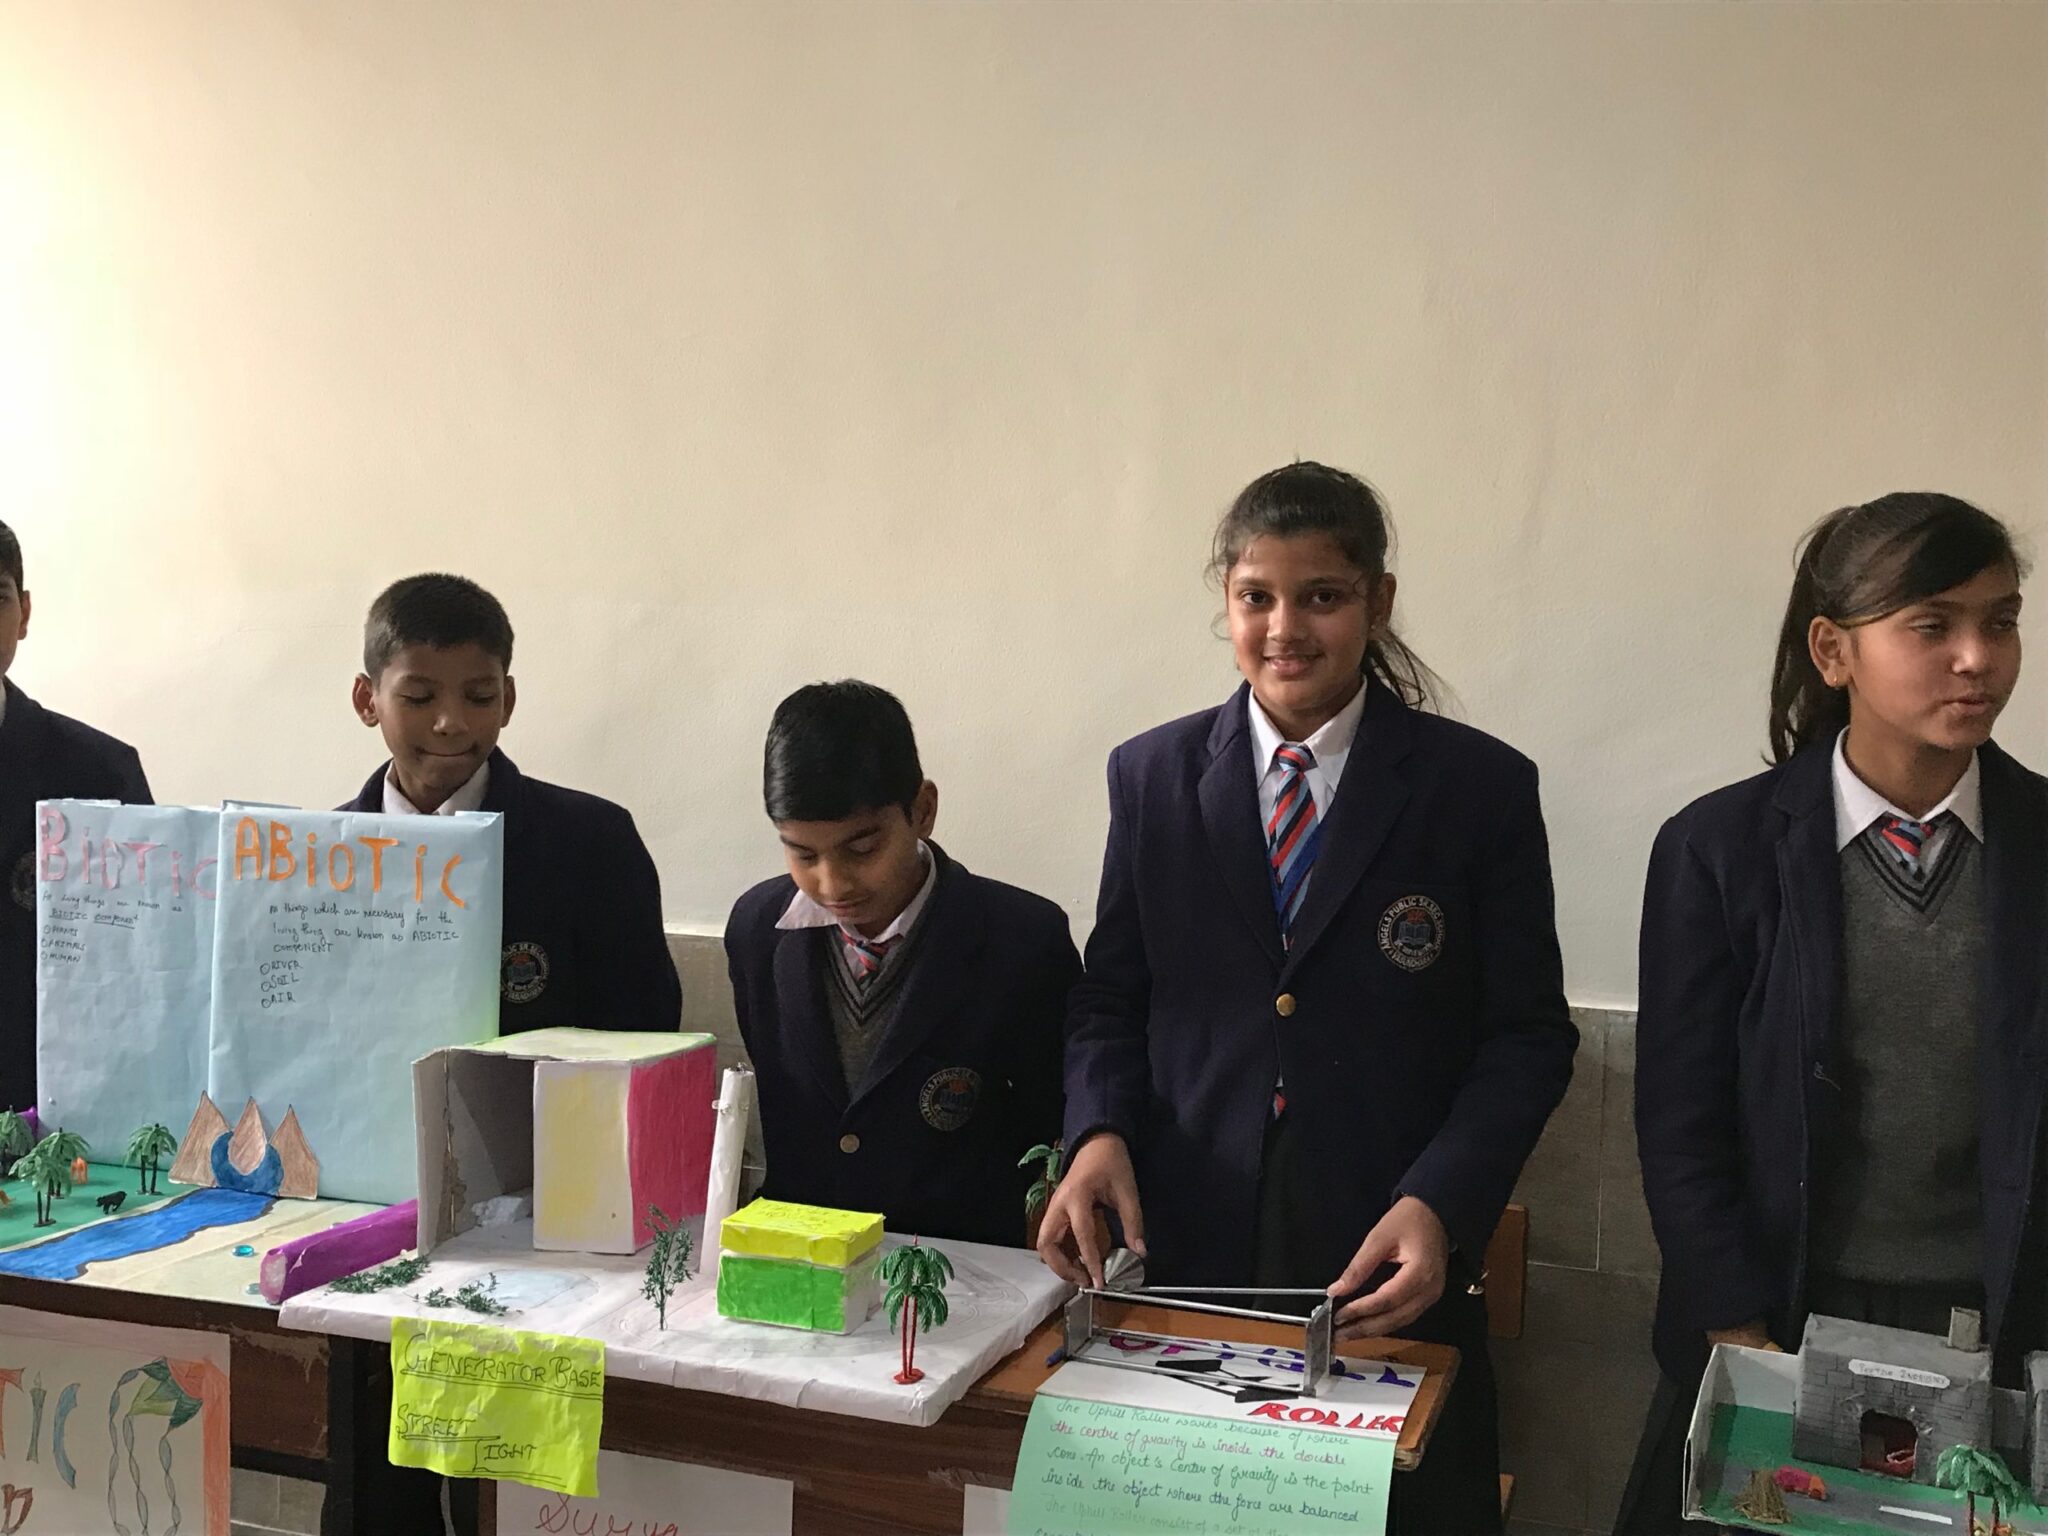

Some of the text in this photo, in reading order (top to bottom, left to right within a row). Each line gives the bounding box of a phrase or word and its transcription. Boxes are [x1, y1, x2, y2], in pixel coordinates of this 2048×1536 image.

[314, 902, 340, 915] which
[416, 908, 428, 925] for
[438, 911, 453, 924] the
[1388, 897, 1417, 917] PUBLIC
[334, 928, 351, 936] are
[357, 927, 384, 940] known
[391, 934, 404, 942] as
[270, 972, 299, 988] SOIL
[271, 959, 303, 971] RIVER
[271, 991, 296, 1003] AIR
[404, 1333, 601, 1388] GENERATOR BASE
[396, 1403, 476, 1437] STREET
[1056, 1399, 1080, 1414] The
[1088, 1402, 1126, 1420] Uphill
[1224, 1422, 1280, 1438] because
[1288, 1429, 1303, 1449] of
[1248, 1402, 1404, 1433] ROLLER
[472, 1438, 537, 1473] LIGHT
[1050, 1420, 1075, 1434] the
[1125, 1429, 1139, 1450] of
[1142, 1434, 1187, 1460] gravity
[1192, 1439, 1206, 1449] is
[1213, 1438, 1253, 1455] inside
[1258, 1443, 1286, 1460] the
[1294, 1450, 1347, 1465] double
[1085, 1447, 1105, 1469] An
[1112, 1449, 1163, 1475] object's
[1211, 1463, 1224, 1487] of
[1284, 1472, 1298, 1486] is
[1303, 1474, 1328, 1490] the
[1331, 1477, 1374, 1499] point
[1042, 1468, 1084, 1489] inside
[1092, 1477, 1115, 1492] the
[1123, 1479, 1163, 1508] object
[1167, 1487, 1201, 1502] where
[1208, 1491, 1231, 1506] the
[1268, 1503, 1293, 1514] are
[1300, 1501, 1359, 1523] balanced
